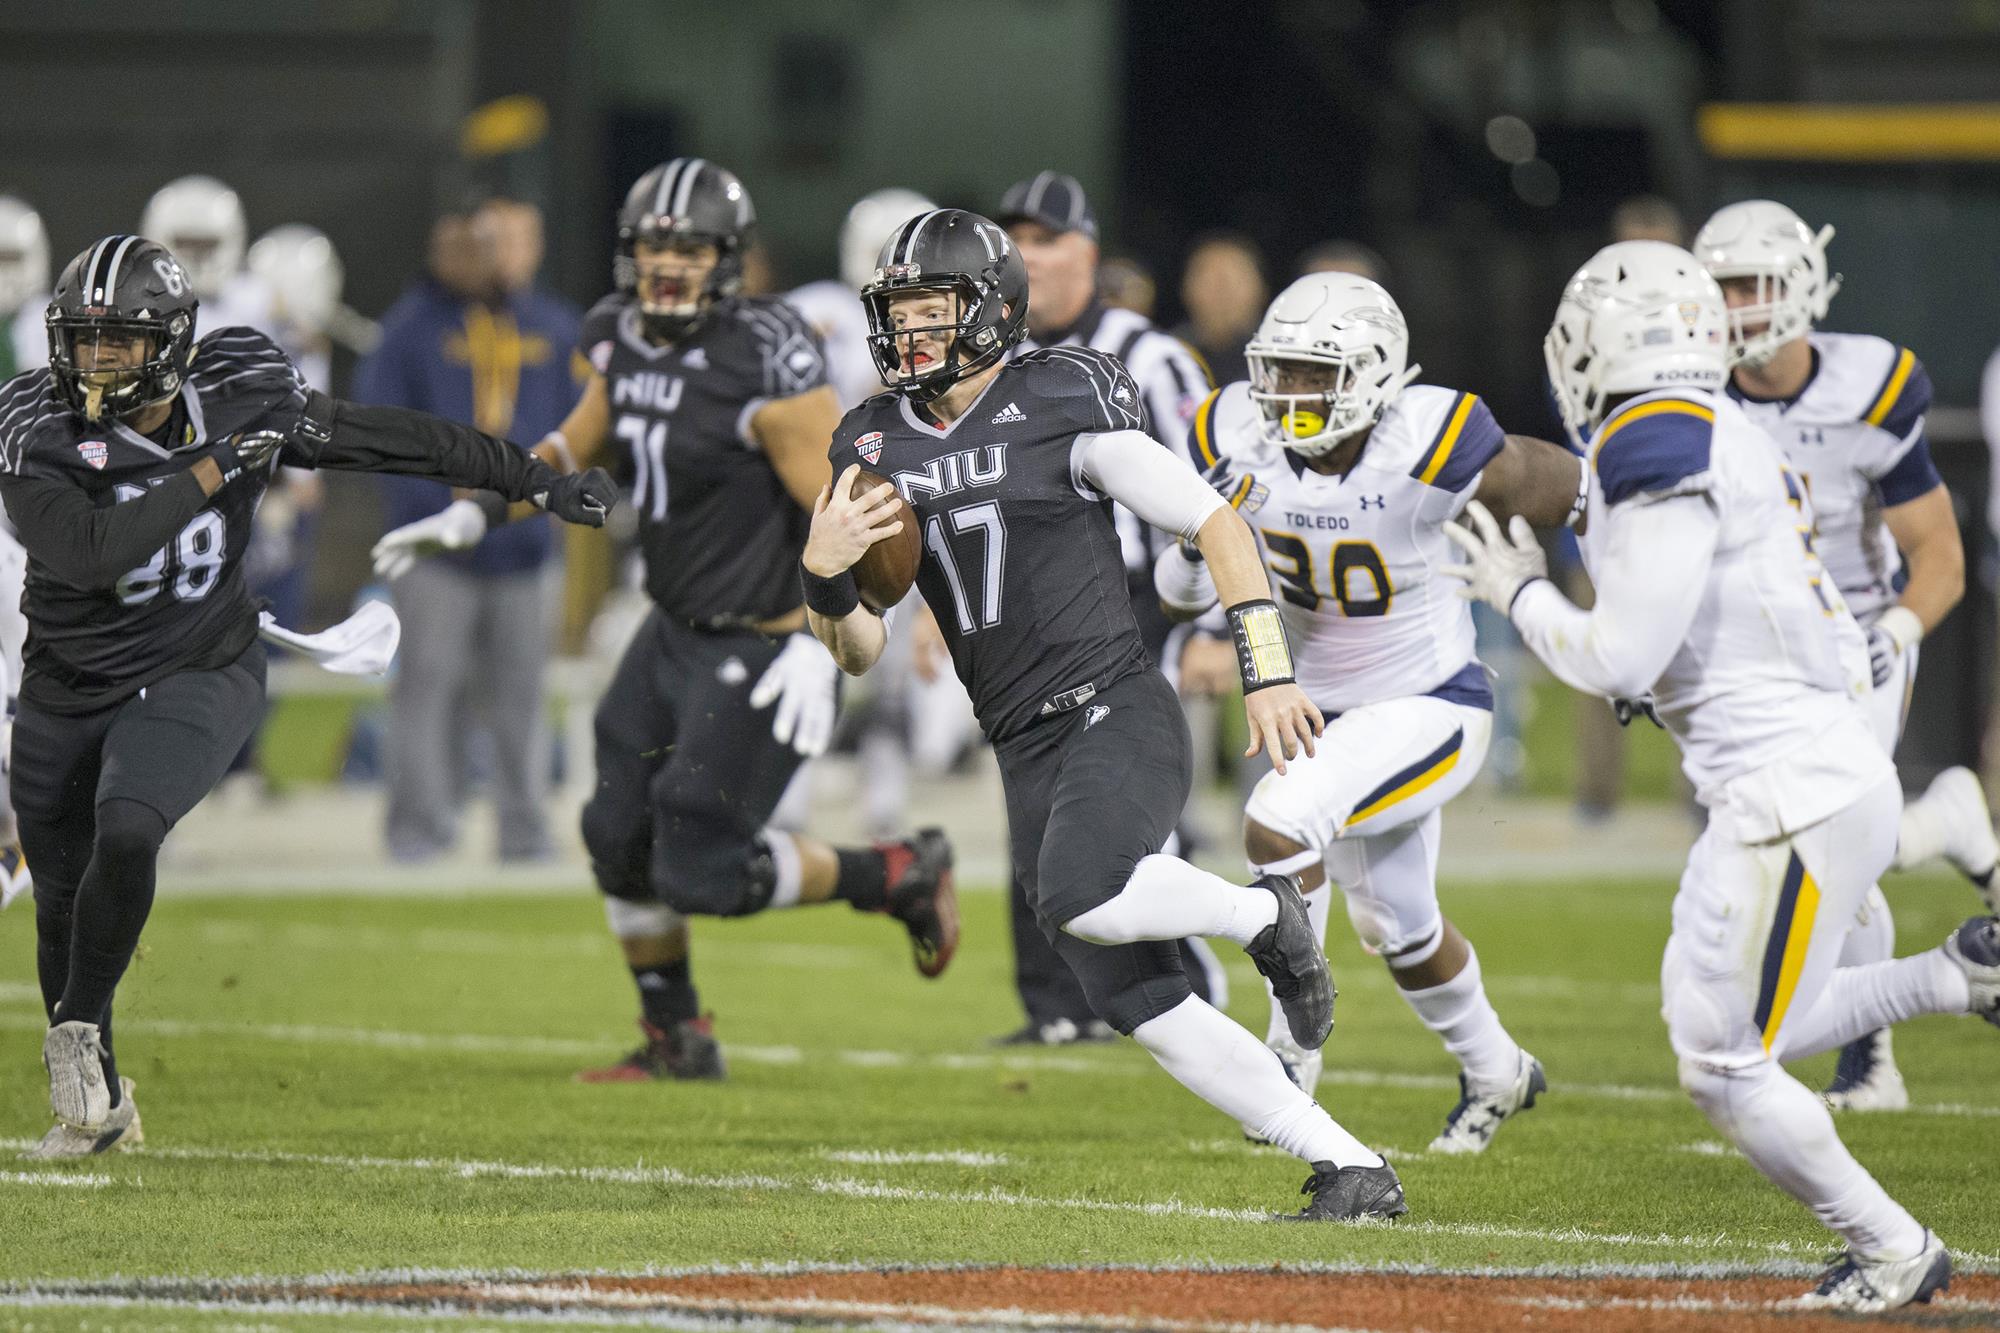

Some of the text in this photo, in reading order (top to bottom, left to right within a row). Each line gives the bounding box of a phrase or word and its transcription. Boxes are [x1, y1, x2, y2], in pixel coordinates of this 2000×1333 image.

[973, 222, 1010, 262] 17
[613, 370, 684, 413] NIU
[991, 413, 1027, 424] adidas
[615, 414, 669, 521] 71
[857, 438, 883, 456] MAC
[891, 442, 1009, 505] NIU
[1284, 511, 1350, 531] TOLEDO
[924, 498, 1008, 636] 17
[1260, 527, 1396, 618] 30
